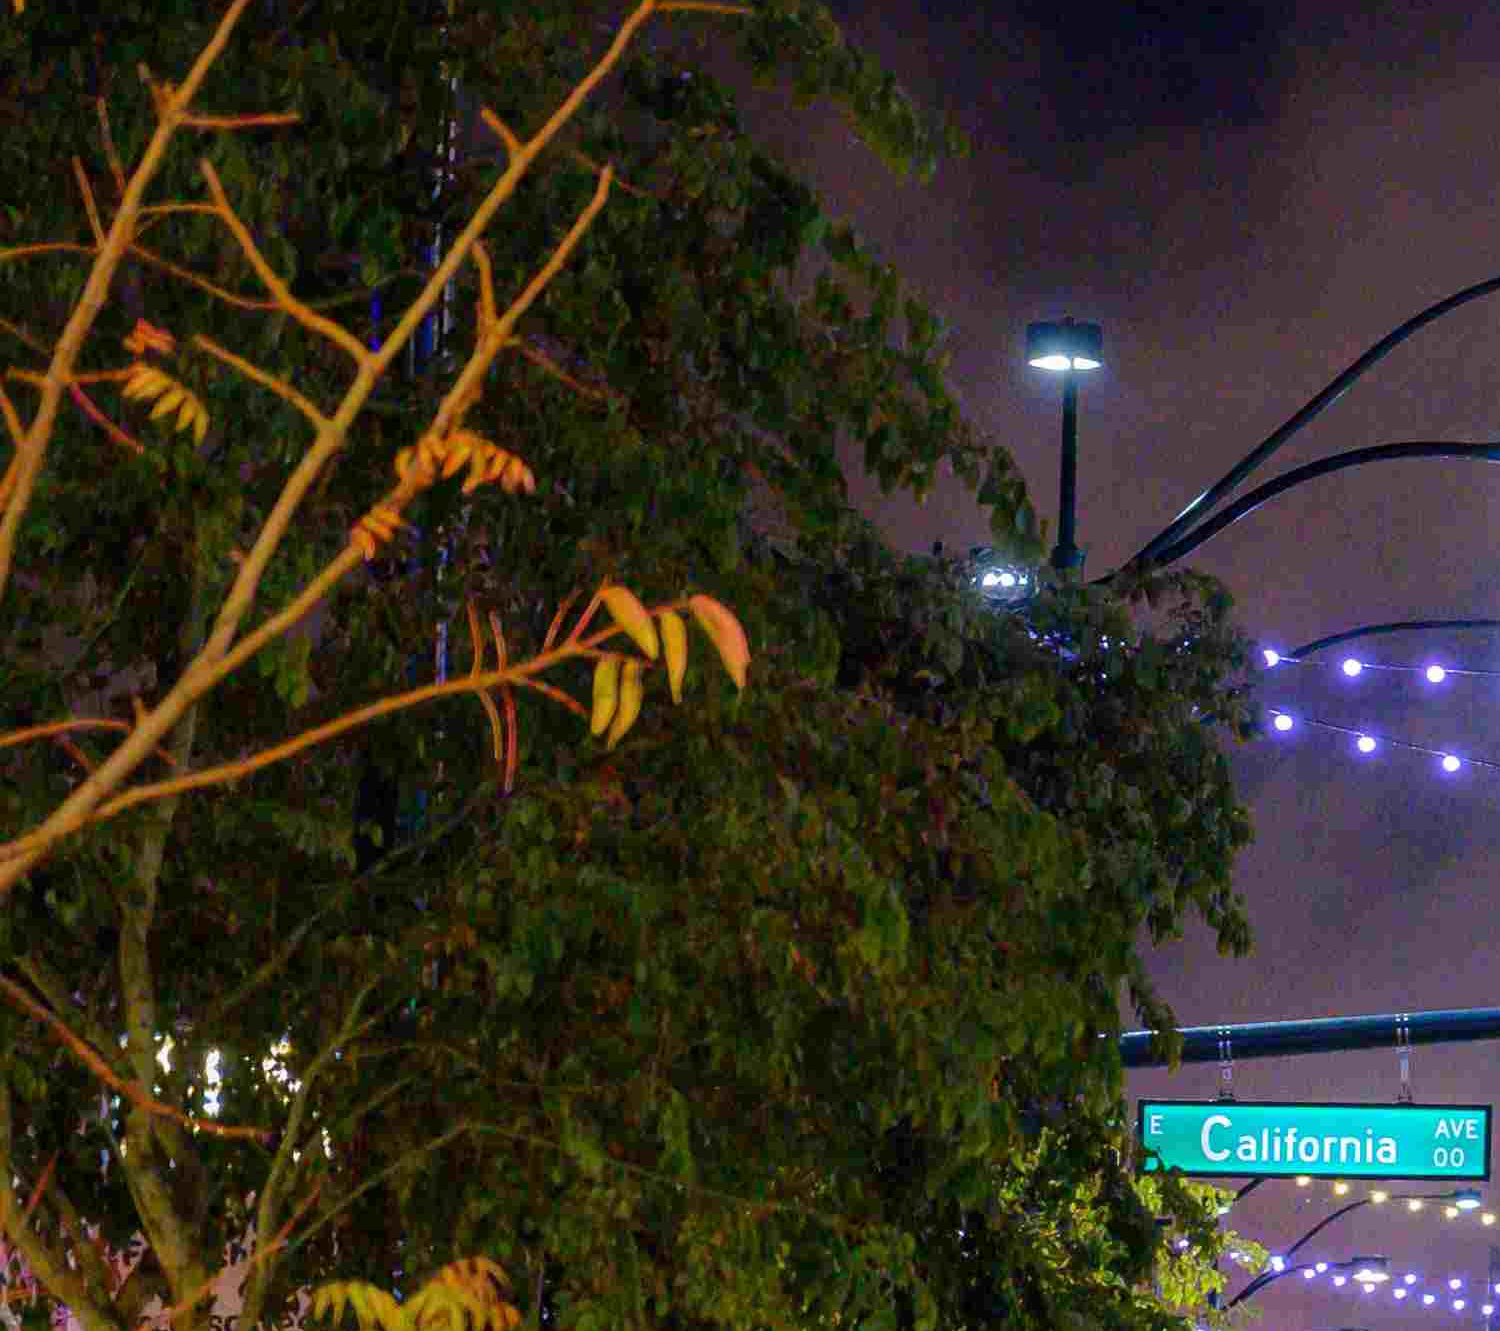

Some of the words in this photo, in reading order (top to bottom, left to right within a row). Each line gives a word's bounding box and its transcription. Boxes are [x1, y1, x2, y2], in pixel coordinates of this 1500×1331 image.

[1150, 1115, 1164, 1135] E
[1434, 1118, 1478, 1140] AVE
[1201, 1114, 1397, 1163] California
